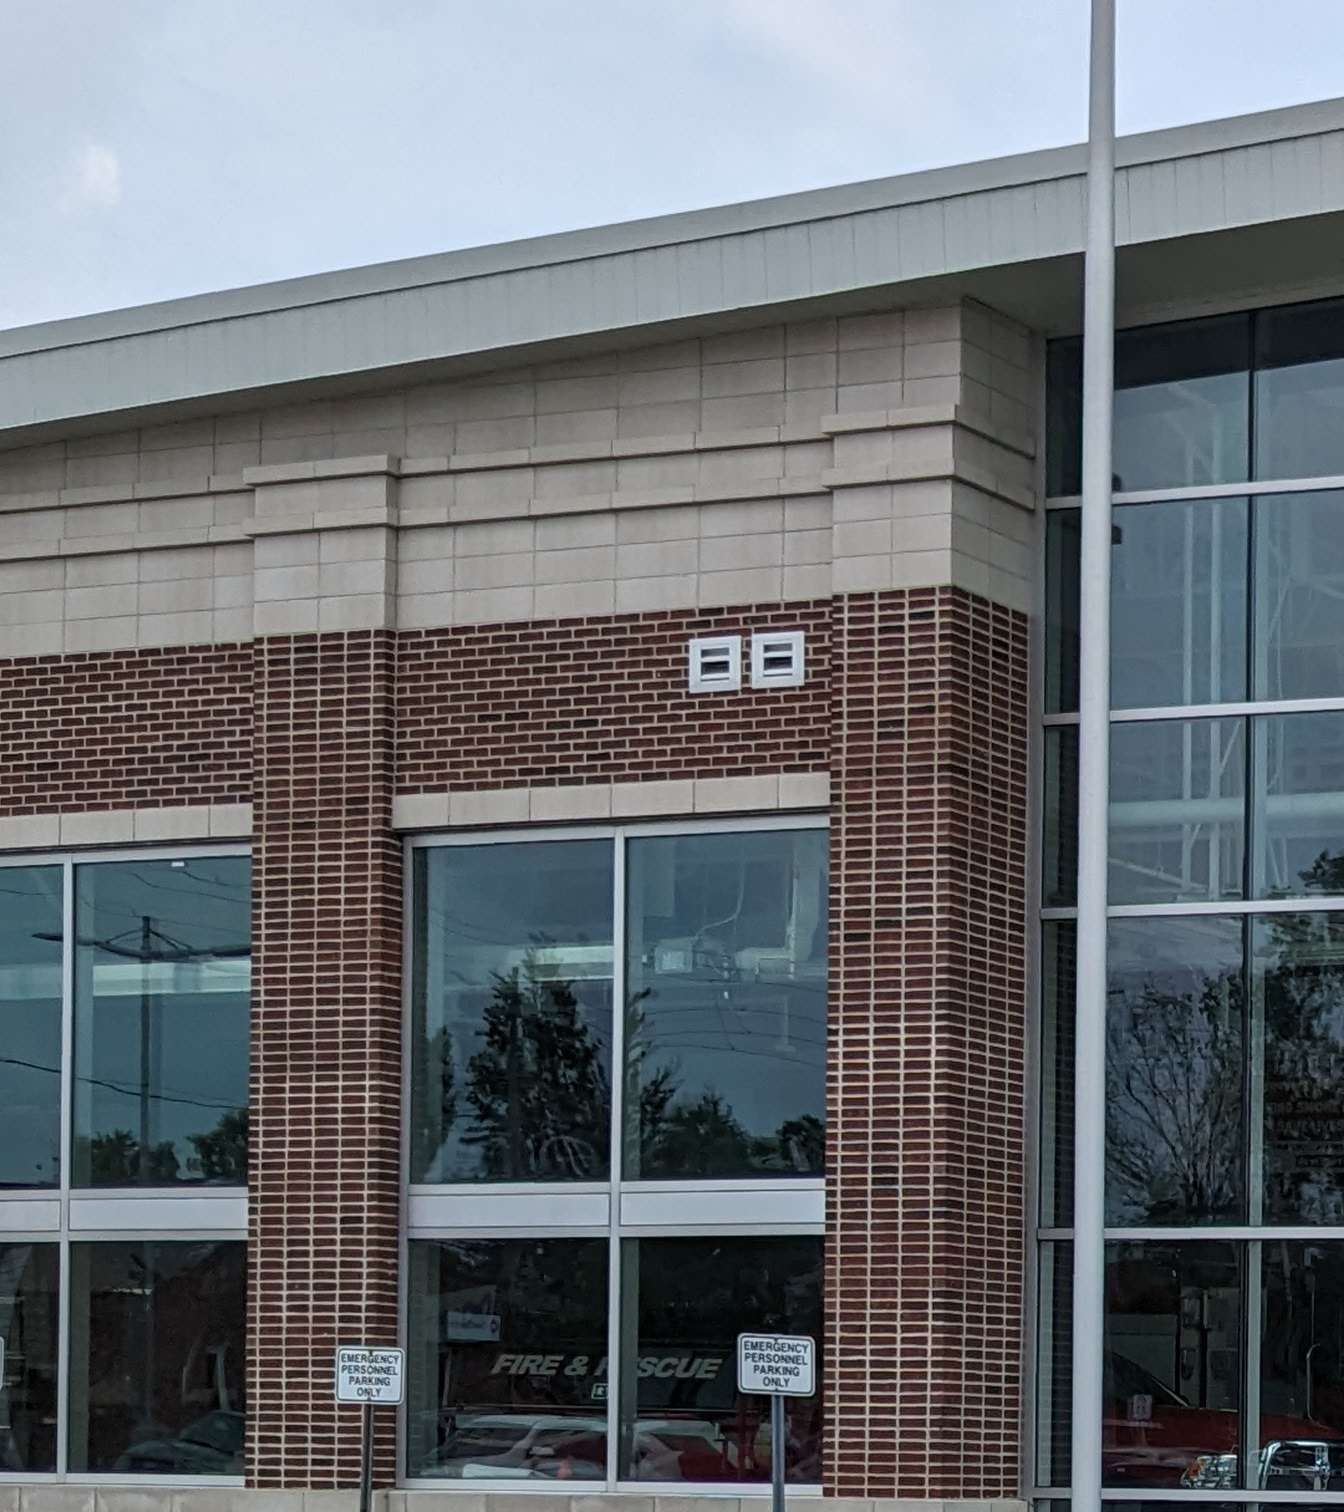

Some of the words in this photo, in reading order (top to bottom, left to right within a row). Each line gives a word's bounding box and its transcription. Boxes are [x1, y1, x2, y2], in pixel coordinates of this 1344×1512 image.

[744, 1341, 809, 1353] EMERGENCY
[341, 1353, 399, 1364] EMERGENCY
[744, 1353, 808, 1365] PERSONNEL
[341, 1365, 398, 1375] PERSONNEL
[491, 1354, 564, 1376] FIRE
[564, 1356, 589, 1376] &
[753, 1365, 800, 1376] PARKING
[348, 1376, 391, 1386] PARKING
[762, 1376, 790, 1387] ONLY
[356, 1387, 381, 1397] ONLY
